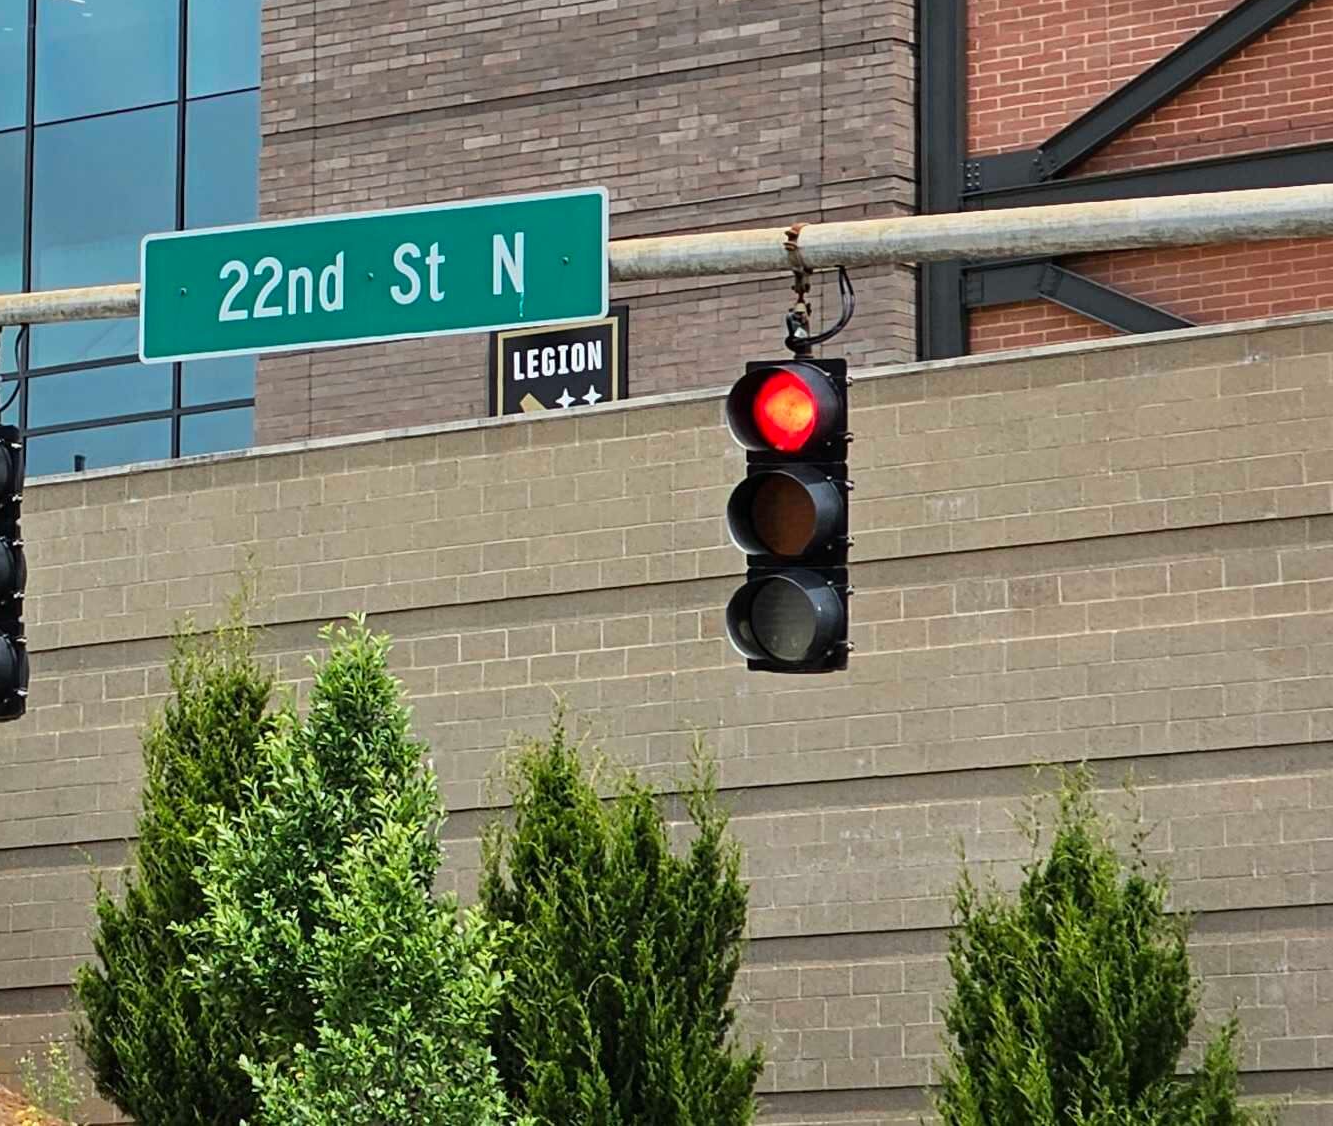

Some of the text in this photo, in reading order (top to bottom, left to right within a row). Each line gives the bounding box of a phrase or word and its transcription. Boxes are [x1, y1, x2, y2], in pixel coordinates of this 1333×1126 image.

[218, 231, 525, 322] 22nd St N
[513, 340, 603, 381] LEGION
